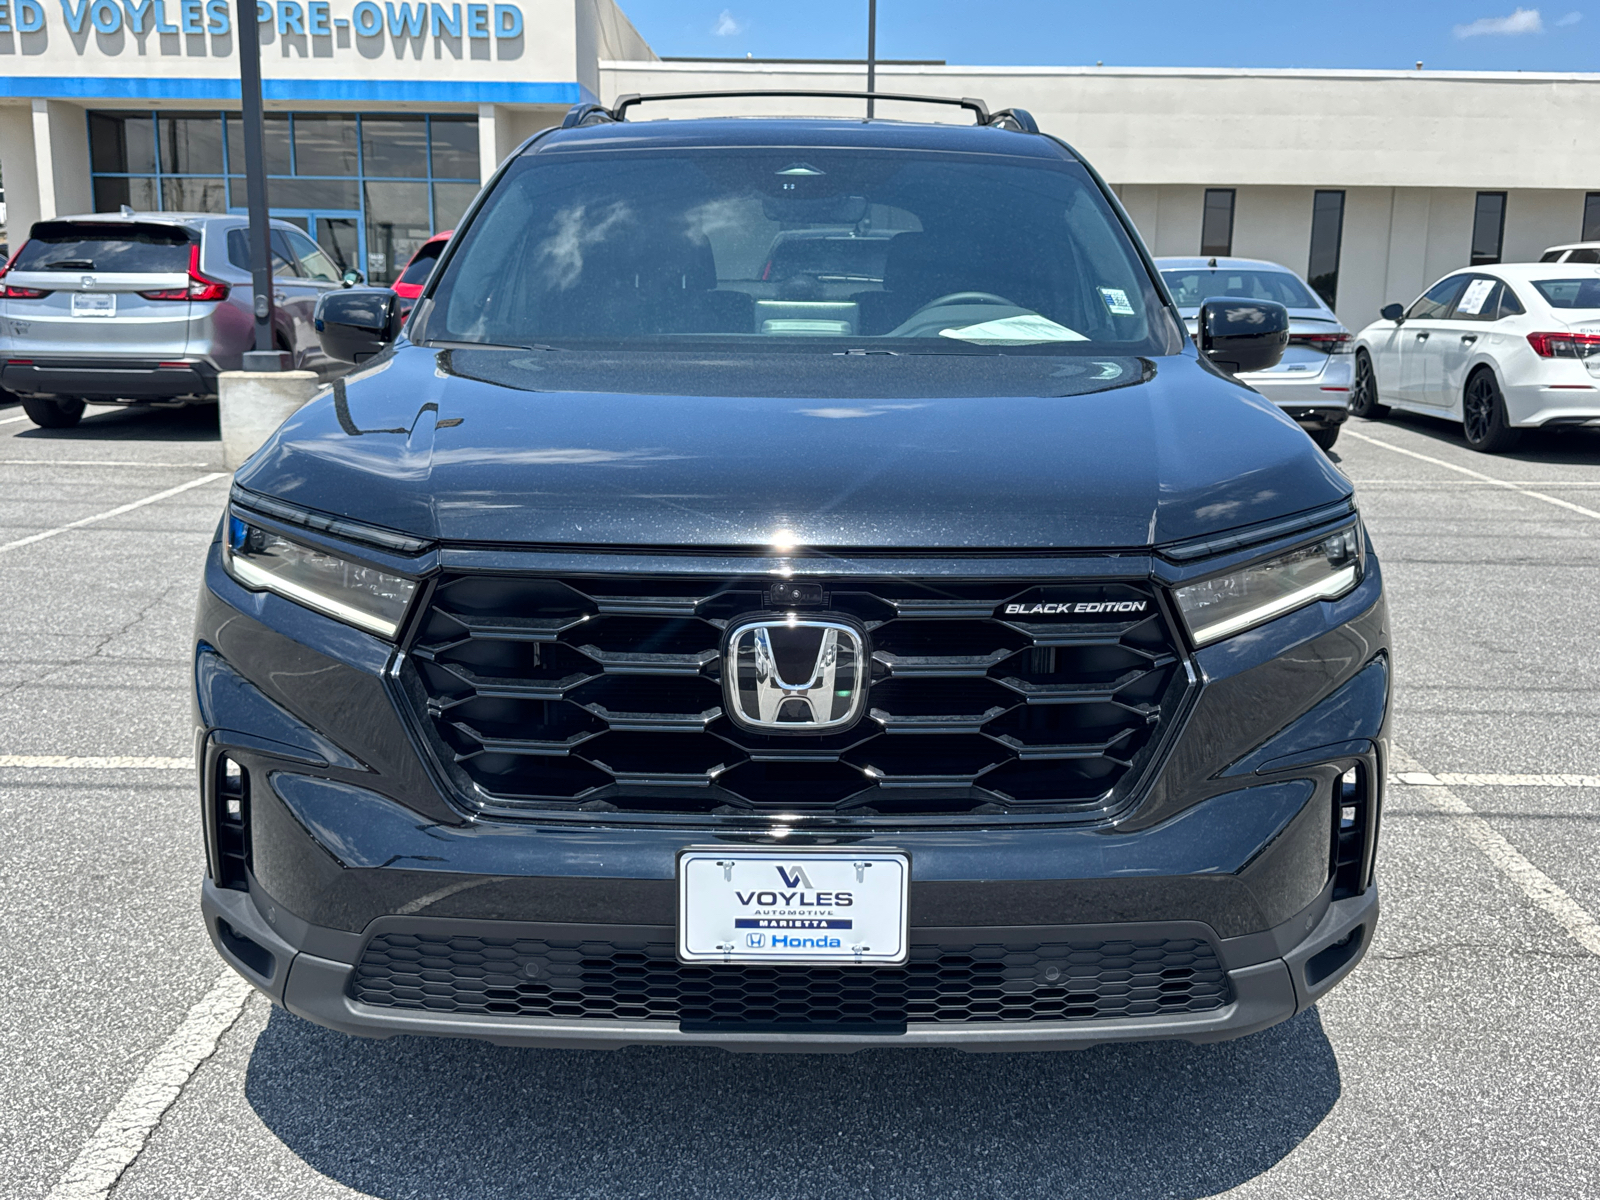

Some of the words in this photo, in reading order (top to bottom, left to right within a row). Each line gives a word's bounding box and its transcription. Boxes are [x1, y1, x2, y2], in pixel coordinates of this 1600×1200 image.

[60, 0, 232, 35] VOYLES
[257, 0, 525, 39] PRE-OWNED
[1004, 602, 1071, 614] BLACK
[1073, 600, 1147, 613] EDITION
[734, 891, 853, 907] VOYLES
[759, 920, 828, 928] MARIETTA
[771, 934, 841, 948] Honda
